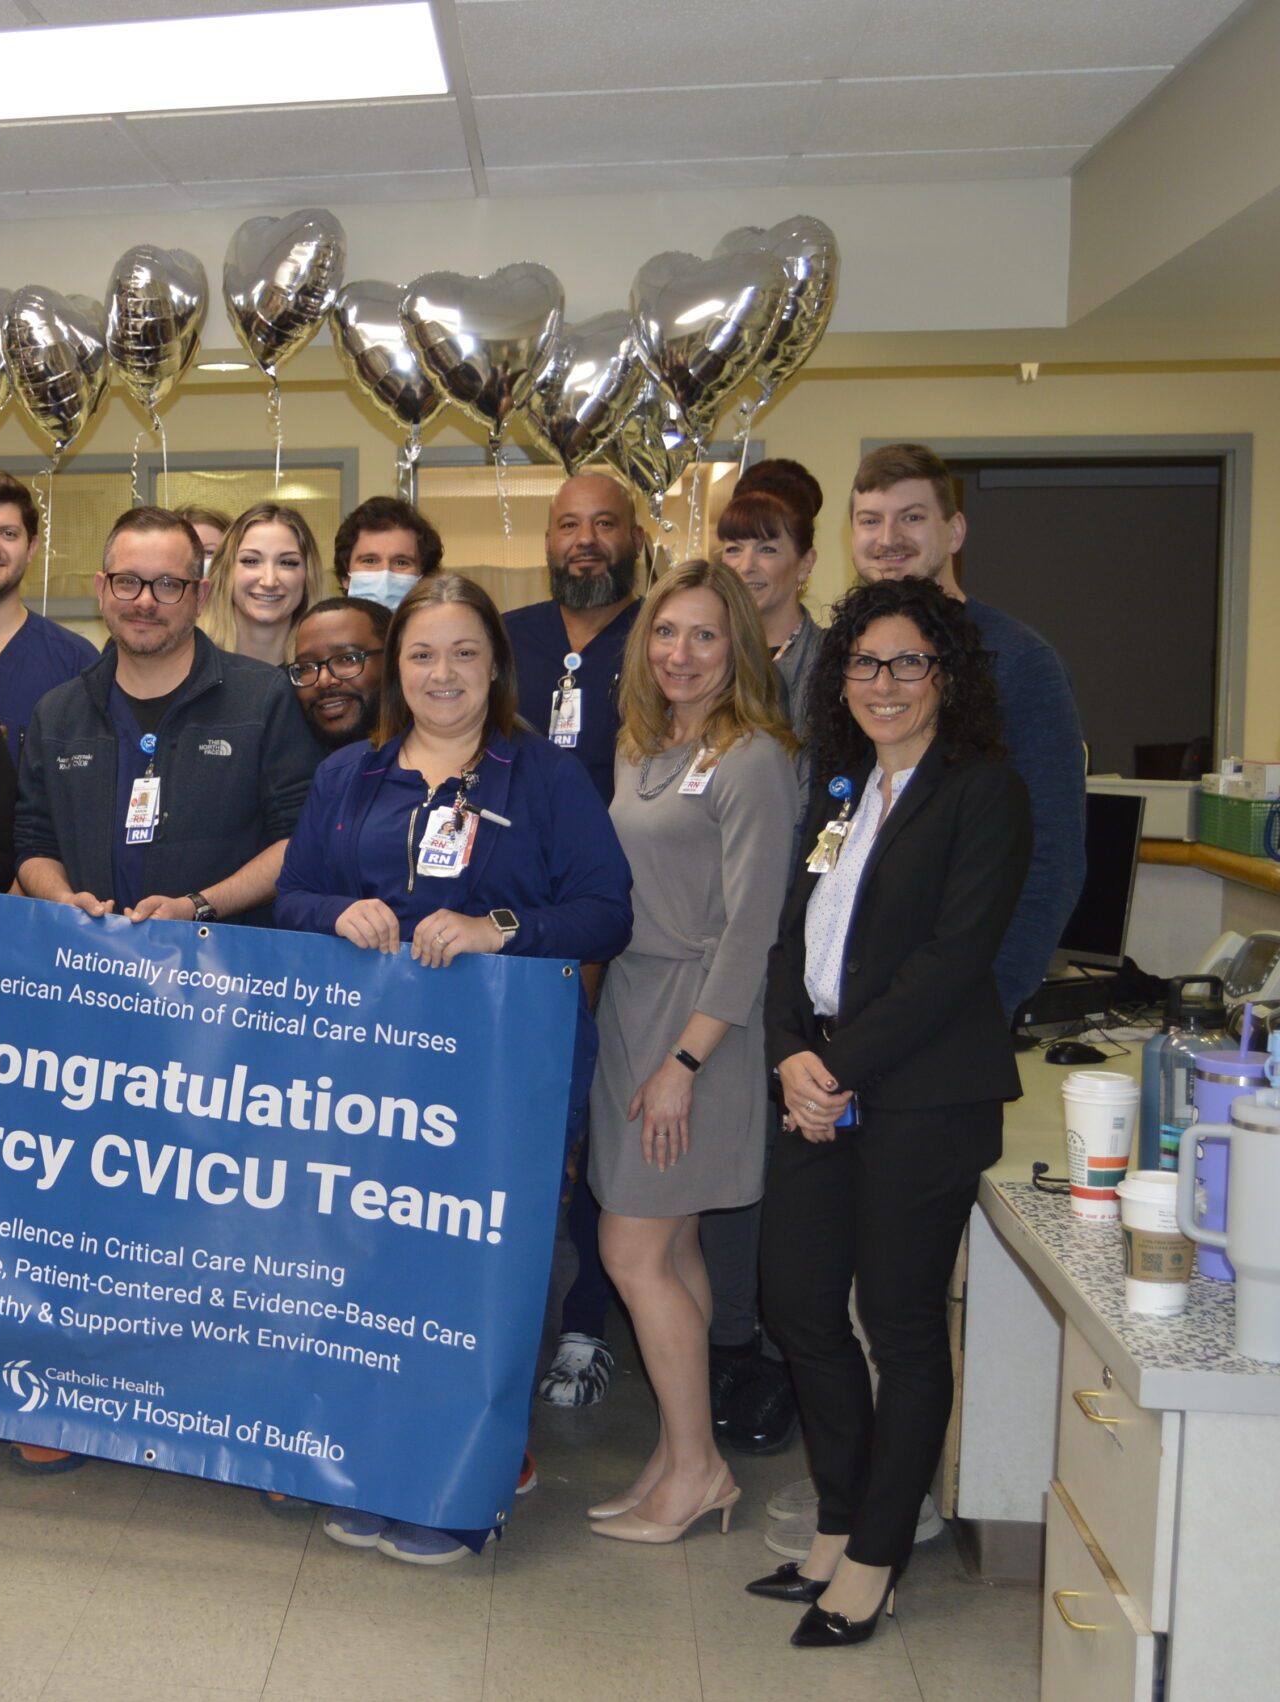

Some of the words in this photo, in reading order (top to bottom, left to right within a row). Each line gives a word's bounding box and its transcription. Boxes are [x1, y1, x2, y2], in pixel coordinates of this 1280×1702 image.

[554, 735, 571, 744] RN
[131, 829, 148, 840] RN
[428, 853, 451, 865] RN
[431, 840, 448, 848] RN
[56, 948, 163, 985] Nationally
[168, 969, 287, 997] recognized
[294, 978, 319, 1006] by
[325, 983, 361, 1006] the
[68, 984, 194, 1020] Association
[202, 1004, 226, 1024] of
[232, 1007, 306, 1035] Critical
[313, 1017, 366, 1042] Care
[375, 1024, 456, 1053] Nurses
[91, 1134, 287, 1209] CVICU
[307, 1162, 506, 1244] Team!
[80, 1232, 97, 1254] in
[105, 1237, 184, 1266] Critical
[192, 1249, 245, 1272] Care
[254, 1255, 345, 1287] Nursing
[15, 1259, 201, 1304] Patient-Centered
[210, 1288, 224, 1306] &
[233, 1290, 415, 1336] Evidence-Based
[423, 1320, 476, 1350] Care
[37, 1302, 53, 1324] &
[60, 1307, 183, 1336] Supportive
[191, 1321, 249, 1344] Work
[258, 1328, 400, 1373] Environment
[46, 1368, 108, 1387] Catholic
[113, 1377, 164, 1396] Health
[56, 1387, 127, 1421] Mercy
[133, 1400, 230, 1437] Hospital
[236, 1421, 262, 1443] of
[264, 1425, 345, 1462] Buffalo
